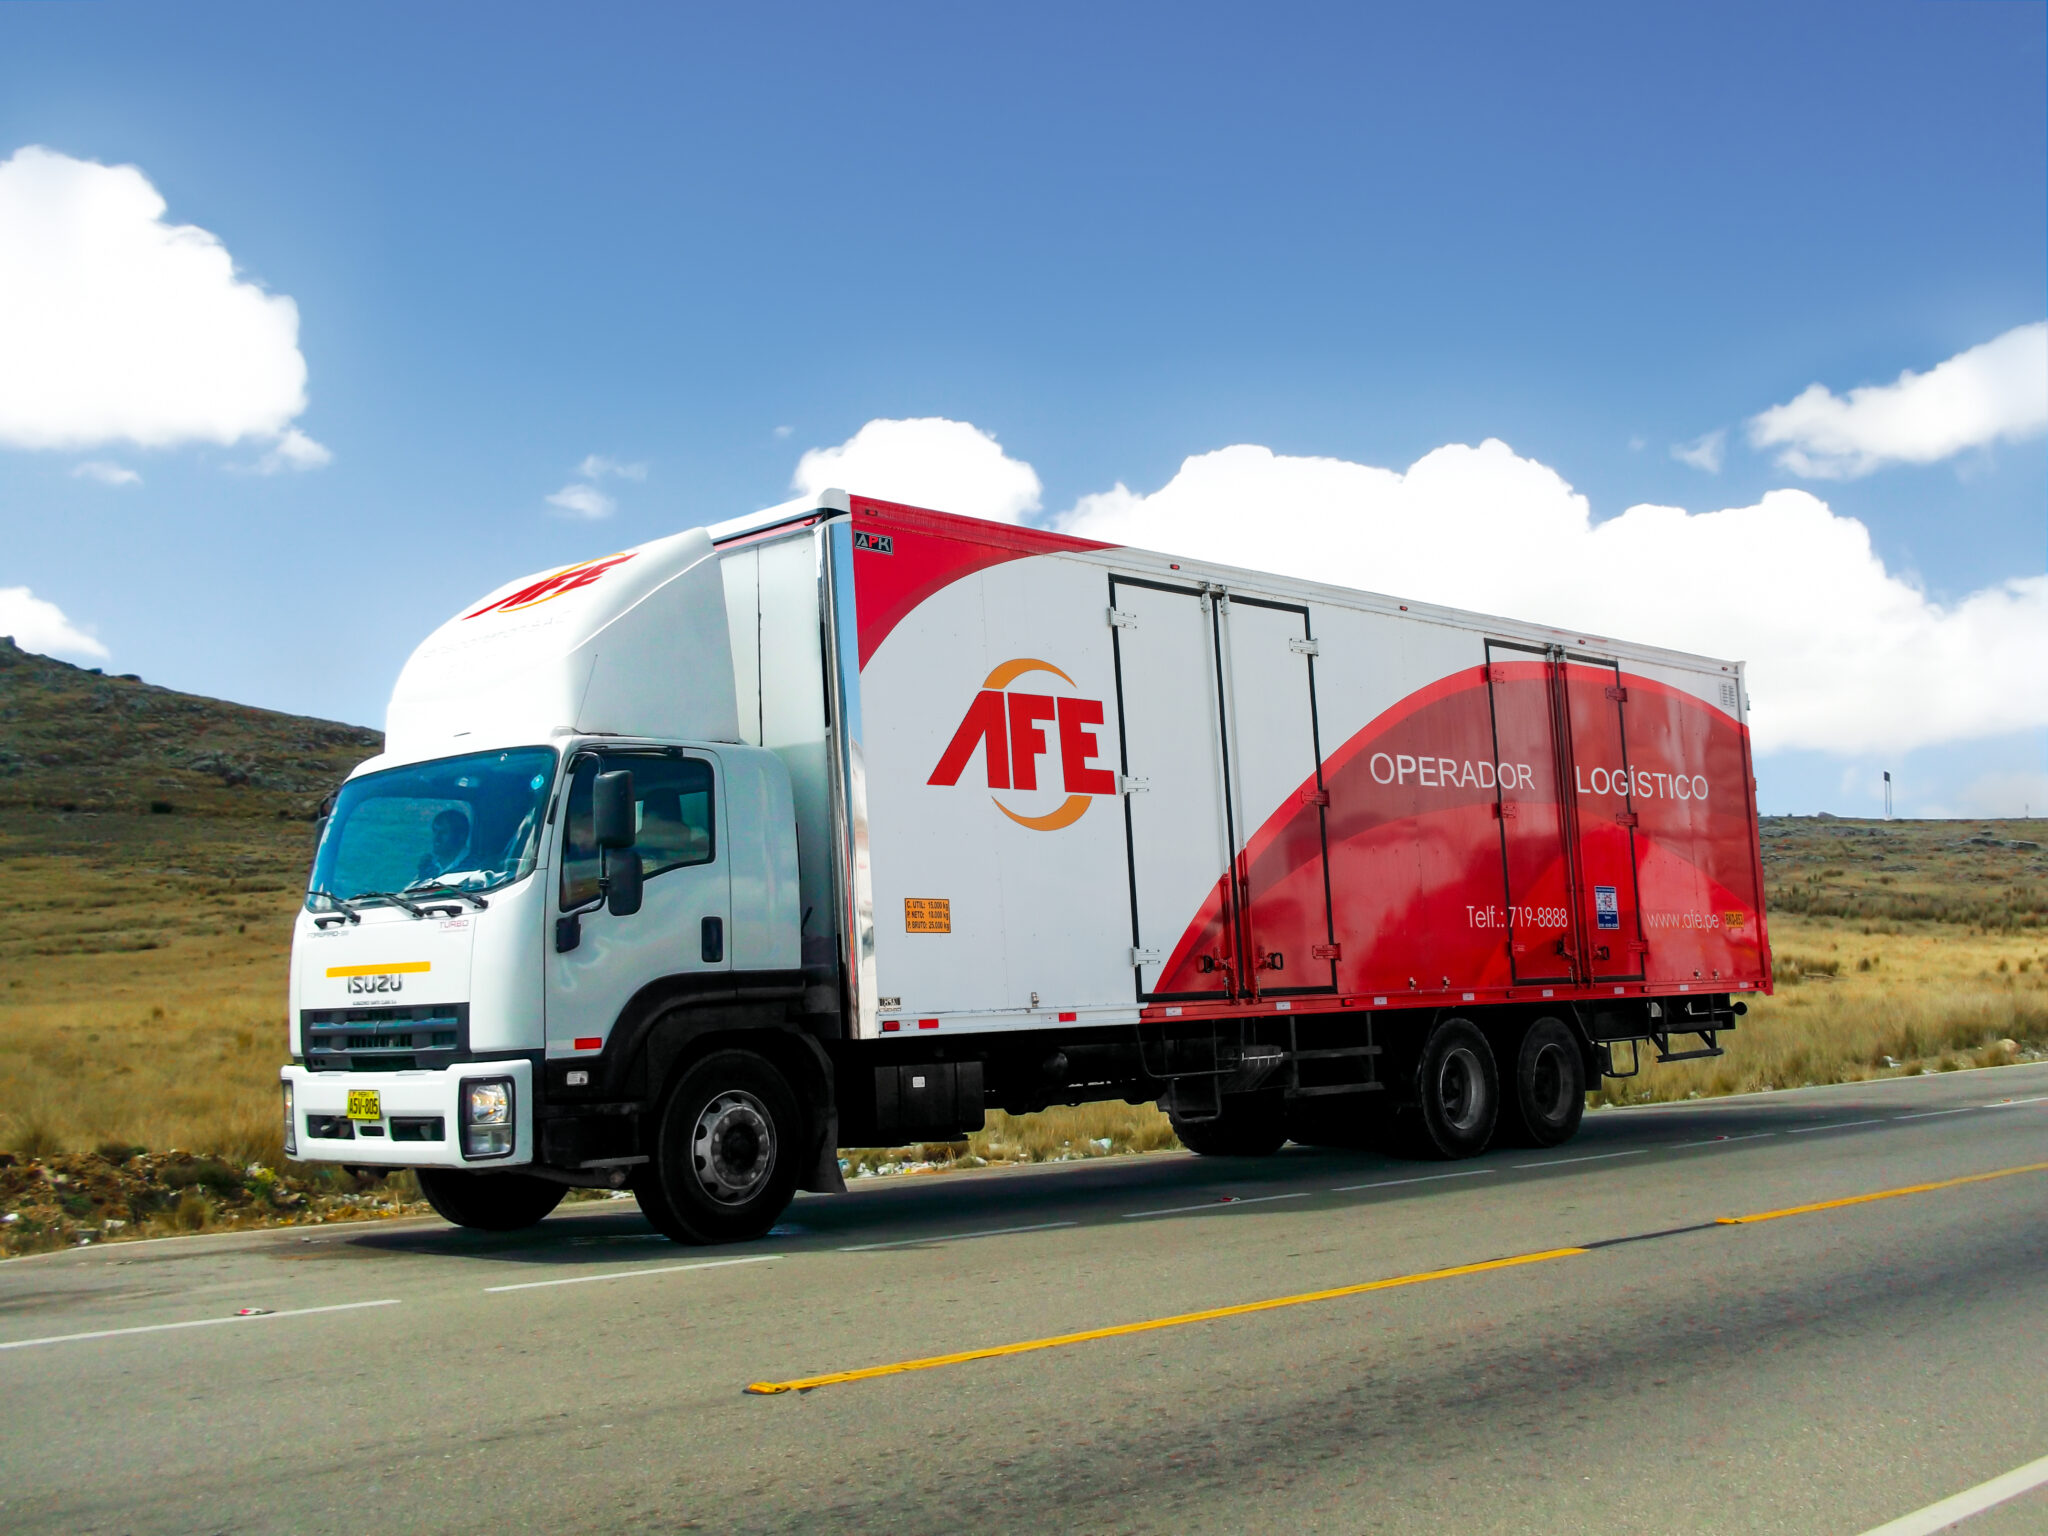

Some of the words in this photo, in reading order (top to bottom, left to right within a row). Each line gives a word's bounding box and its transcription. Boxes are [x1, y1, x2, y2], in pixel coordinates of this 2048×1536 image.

[856, 534, 890, 551] APK
[926, 690, 1117, 795] AFE
[1369, 752, 1536, 790] OPERADOR
[1575, 765, 1709, 801] LOGÍSTICO
[439, 919, 469, 929] TURBO
[1508, 906, 1568, 928] 719-8888
[1646, 908, 1720, 933] www.afe.pe
[347, 973, 403, 994] ISUZU
